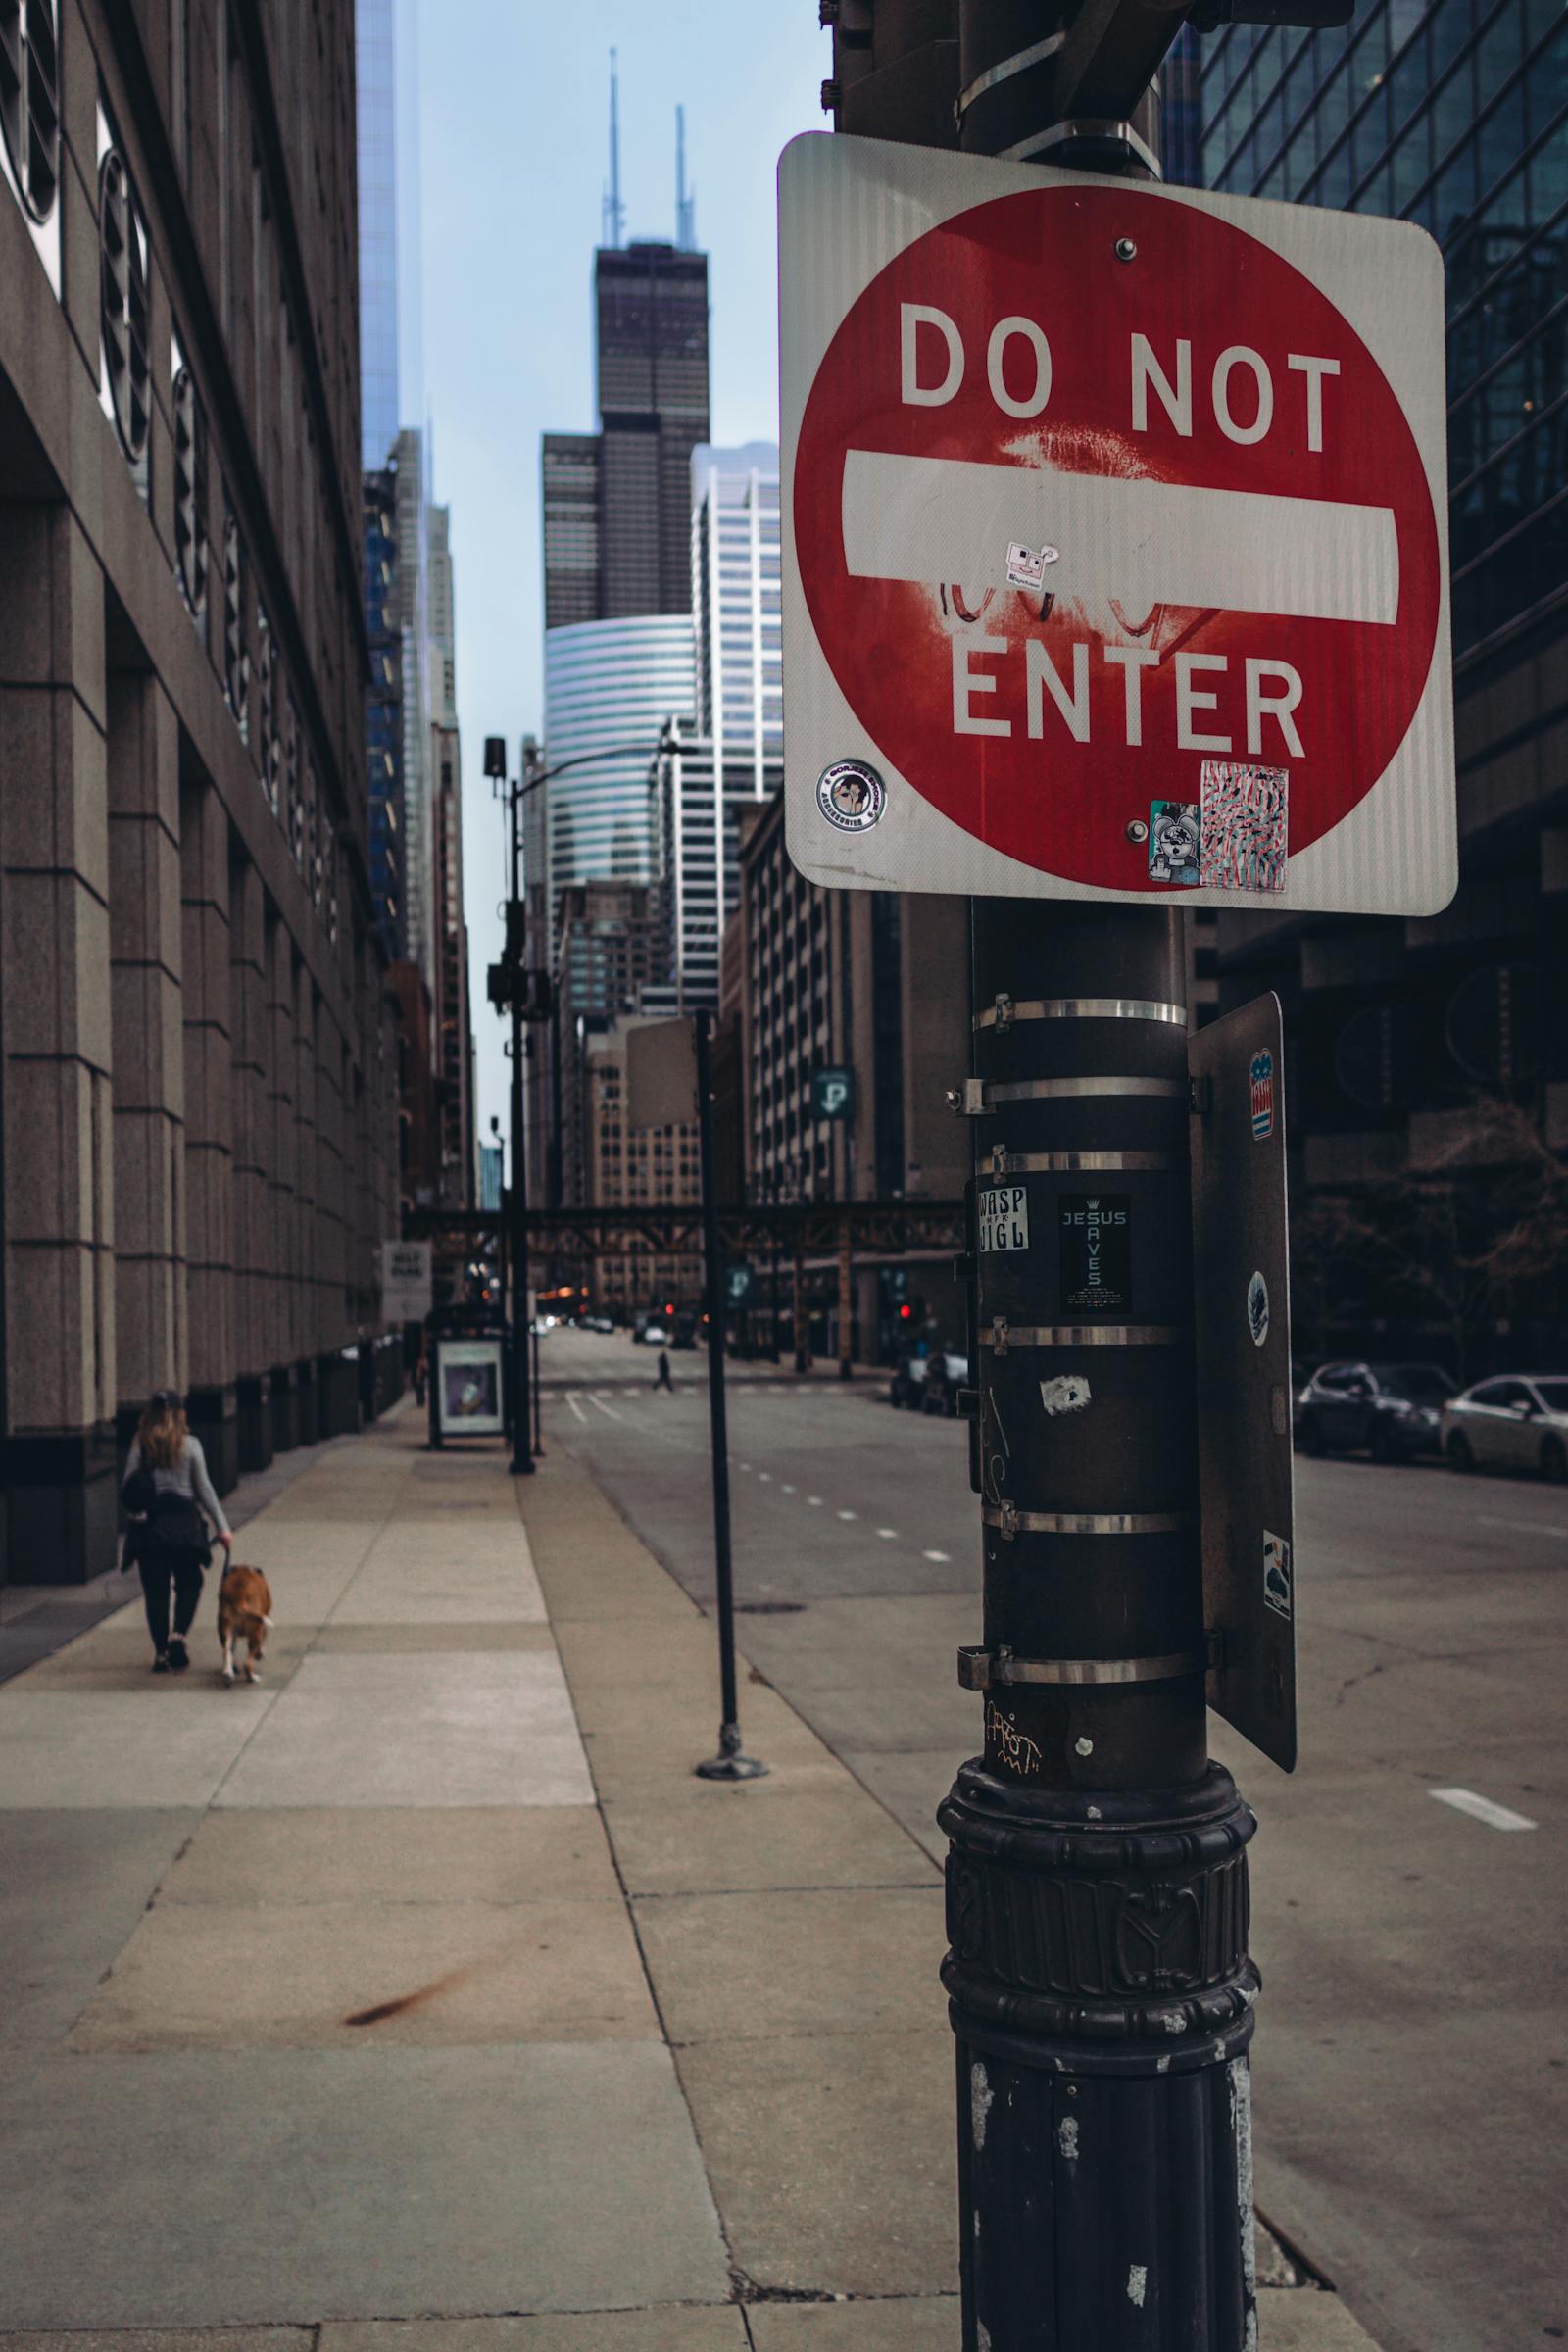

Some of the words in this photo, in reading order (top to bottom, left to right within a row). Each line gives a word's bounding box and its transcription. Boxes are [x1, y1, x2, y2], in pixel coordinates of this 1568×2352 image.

[900, 302, 1054, 418] DO
[1130, 332, 1341, 454] NOT
[952, 633, 1306, 759] ENTER
[980, 1189, 1024, 1217] WASP
[1062, 1211, 1127, 1225] JESUS
